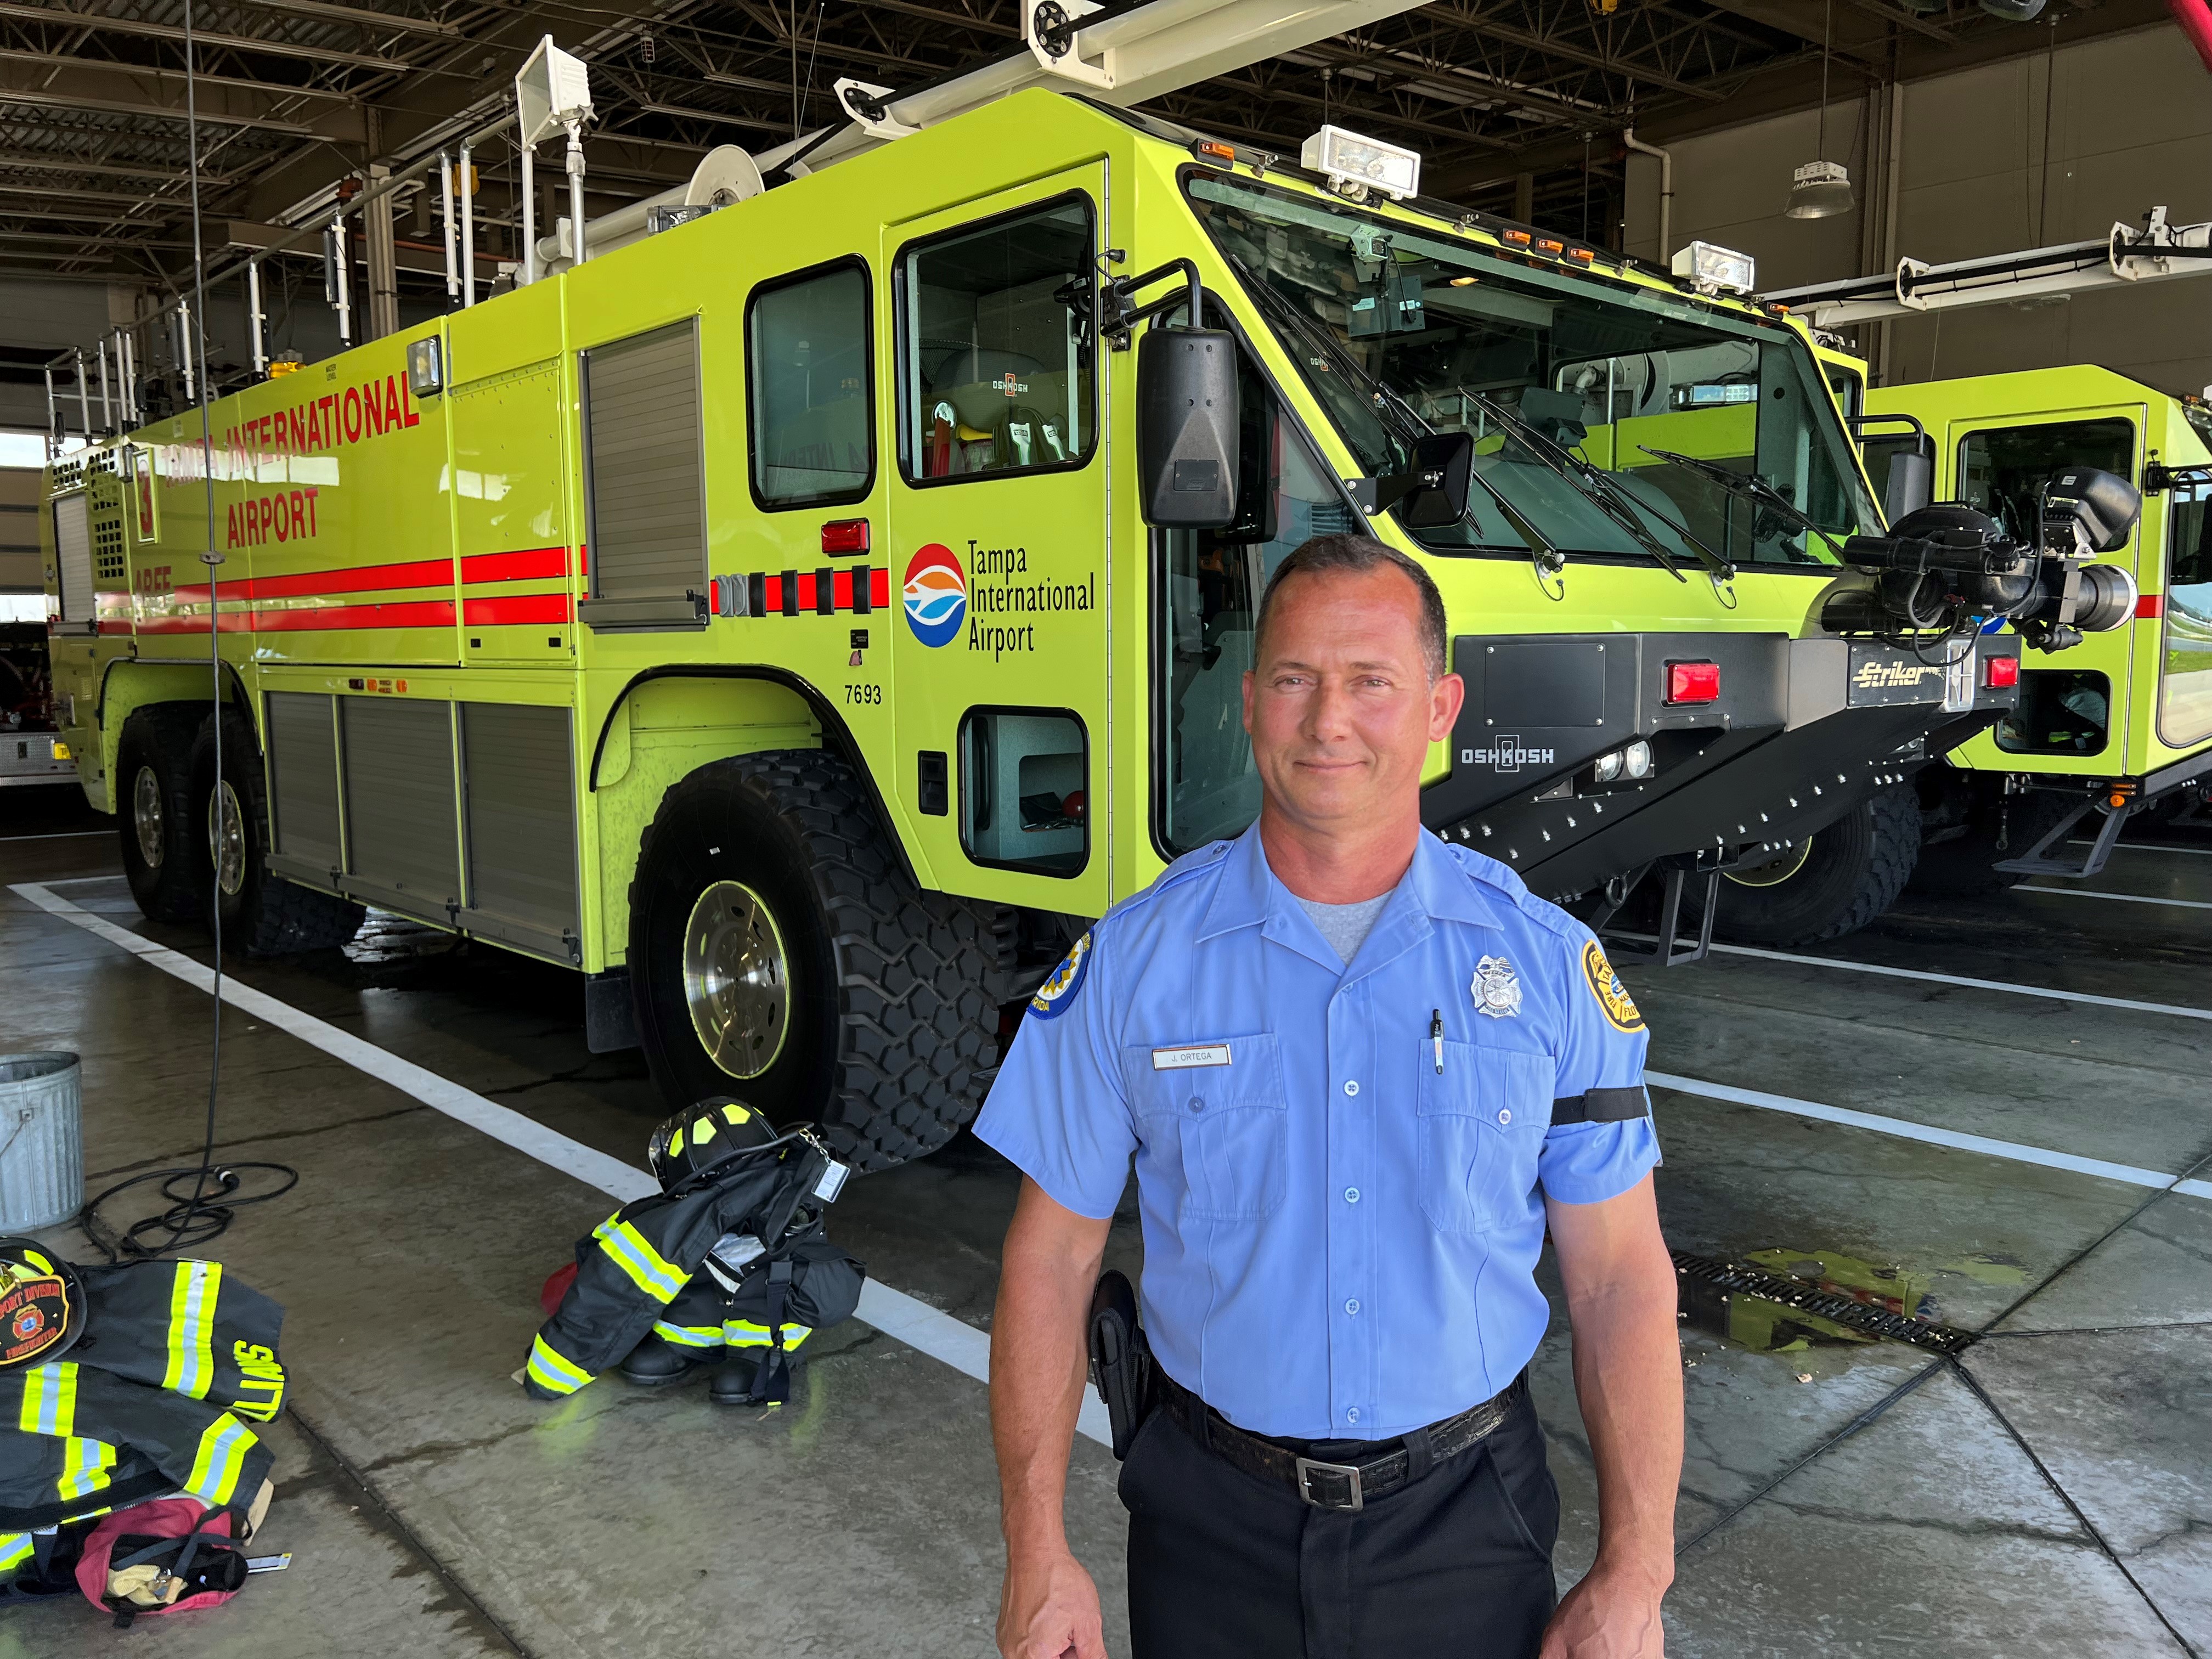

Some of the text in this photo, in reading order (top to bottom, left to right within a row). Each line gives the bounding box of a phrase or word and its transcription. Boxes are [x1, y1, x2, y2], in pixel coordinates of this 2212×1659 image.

[992, 377, 1028, 393] OSHKOSH
[226, 371, 420, 473] INTERNATIONAL
[138, 460, 153, 534] 3
[228, 487, 319, 549] AIRPORT
[968, 540, 1027, 585] Tampa
[971, 572, 1094, 612] International
[969, 617, 1034, 663] Airport
[1852, 661, 1922, 688] Striker
[845, 684, 881, 705] 7693
[1462, 744, 1554, 766] OSHKOSH
[1605, 991, 1617, 1008] FIRE
[1181, 1052, 1212, 1061] ORTEGA
[0, 1283, 60, 1319] PORT DIVISION
